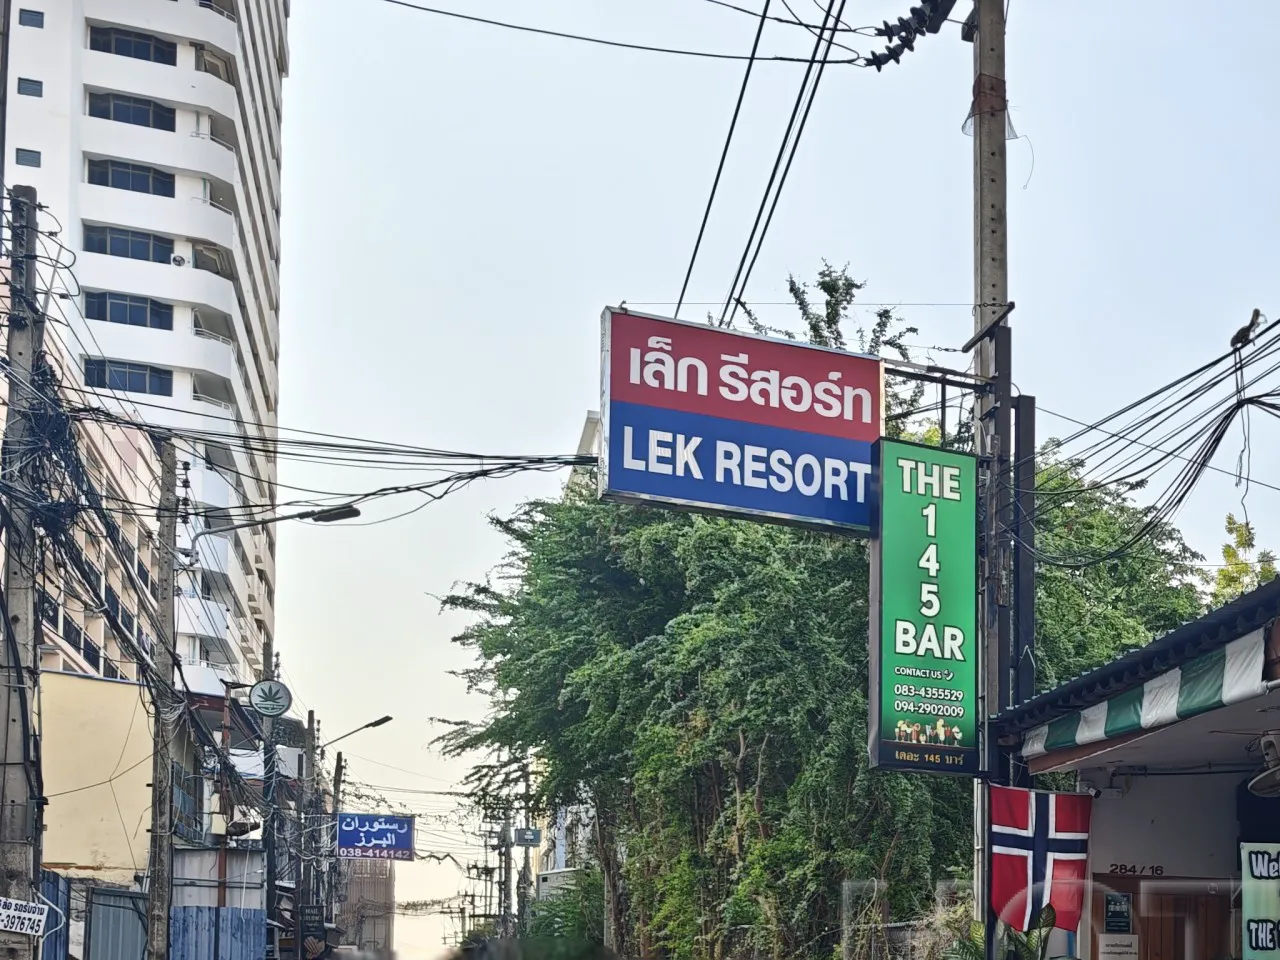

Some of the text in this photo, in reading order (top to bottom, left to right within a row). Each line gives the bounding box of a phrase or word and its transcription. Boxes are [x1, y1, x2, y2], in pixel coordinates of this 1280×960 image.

[628, 335, 873, 424] เล็ก รีสอร์ท
[622, 425, 871, 504] LEK RESORT
[897, 458, 962, 501] THE
[894, 619, 966, 662] BAR
[894, 666, 942, 680] CONTACT US
[893, 683, 964, 702] 083-4355529
[893, 700, 965, 718] 094-2902009
[924, 754, 941, 763] 145
[341, 815, 408, 834] رستوران
[339, 847, 410, 859] 038-414142
[0, 912, 43, 934] -3976745
[1249, 921, 1275, 948] THE
